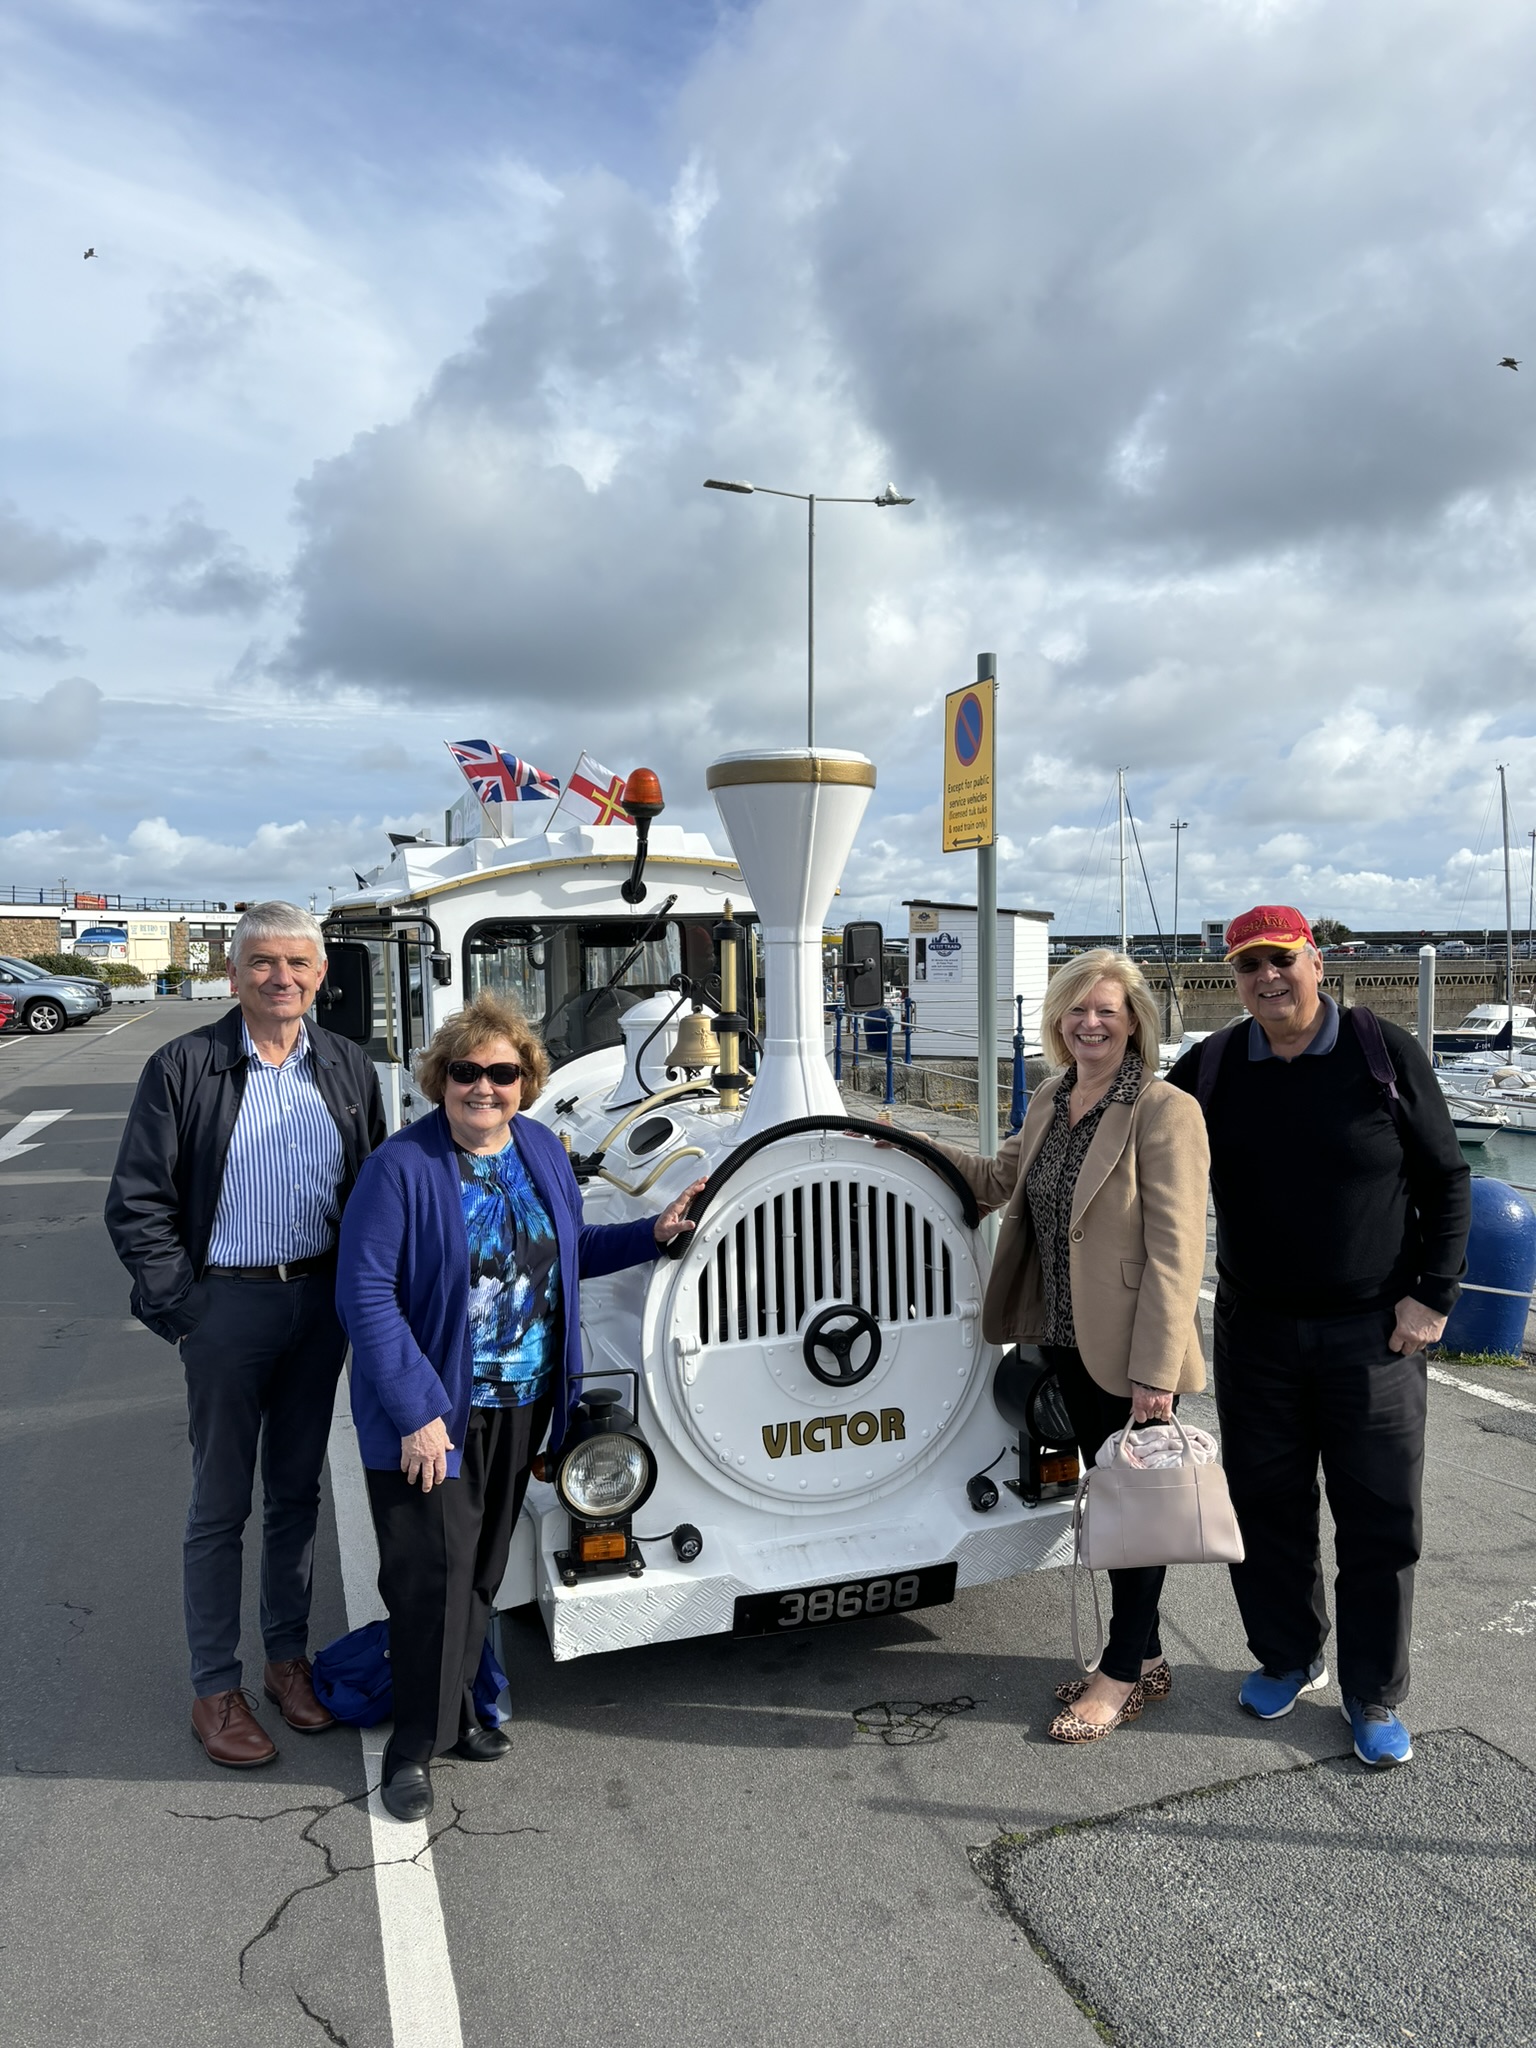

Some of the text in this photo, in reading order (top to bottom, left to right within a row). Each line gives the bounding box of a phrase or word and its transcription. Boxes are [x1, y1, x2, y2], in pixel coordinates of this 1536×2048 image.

[948, 774, 990, 793] Except for public
[949, 792, 987, 808] service vehicles
[949, 804, 988, 820] (licensed tuk tuks
[953, 823, 963, 833] road
[964, 821, 975, 831] train
[975, 818, 988, 830] only)
[1236, 914, 1292, 936] ESPAÑA
[762, 1407, 906, 1459] VICTOR
[777, 1575, 920, 1627] 38688
